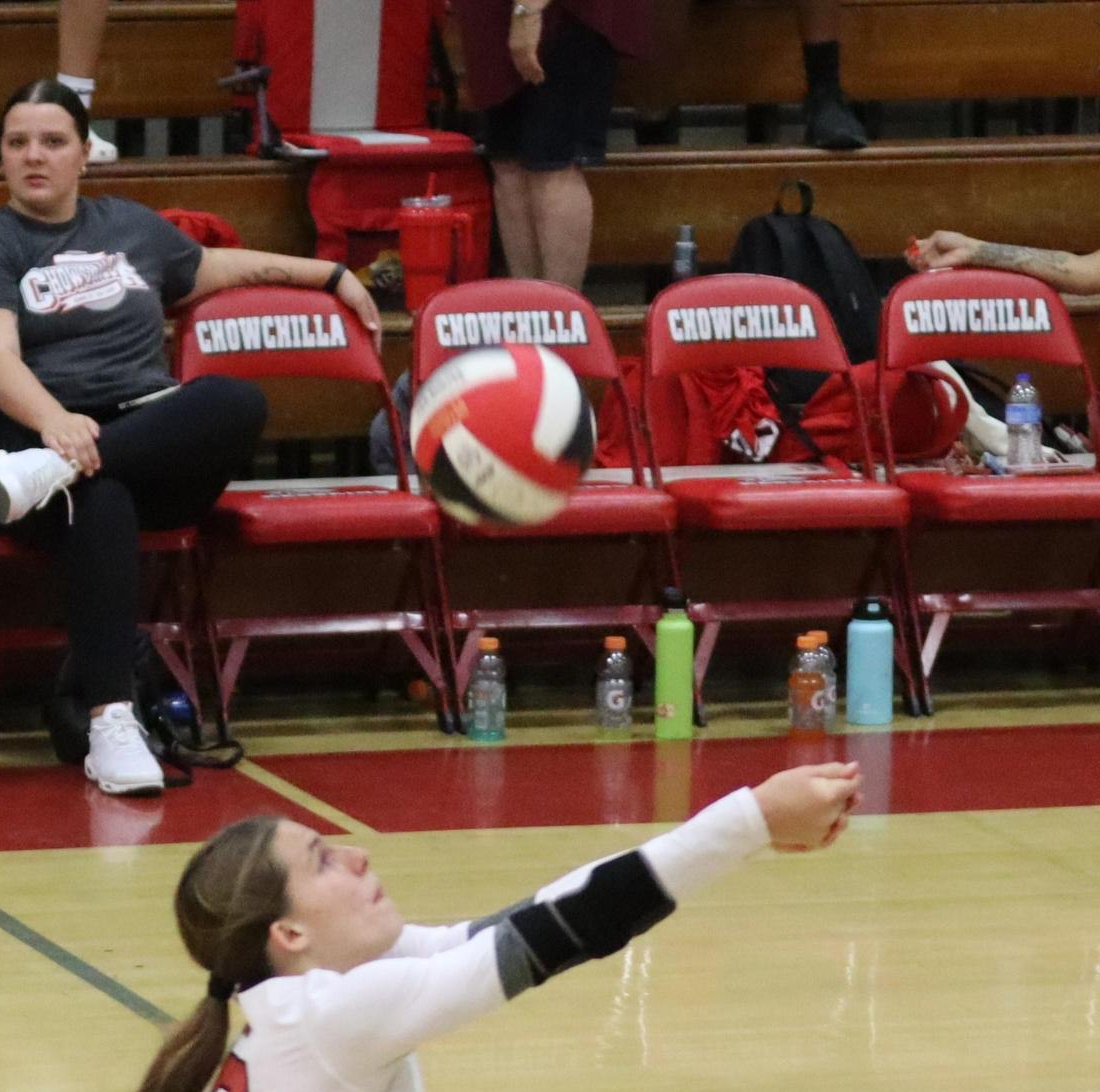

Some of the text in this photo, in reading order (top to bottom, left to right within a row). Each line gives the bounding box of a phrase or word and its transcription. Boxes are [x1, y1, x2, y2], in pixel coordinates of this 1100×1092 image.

[195, 313, 348, 354] CHOWCHILLA
[435, 310, 588, 347] CHOWCHILLA
[668, 304, 817, 342] CHOWCHILLA
[903, 298, 1052, 334] CHOWCHILLA
[606, 690, 626, 711] G
